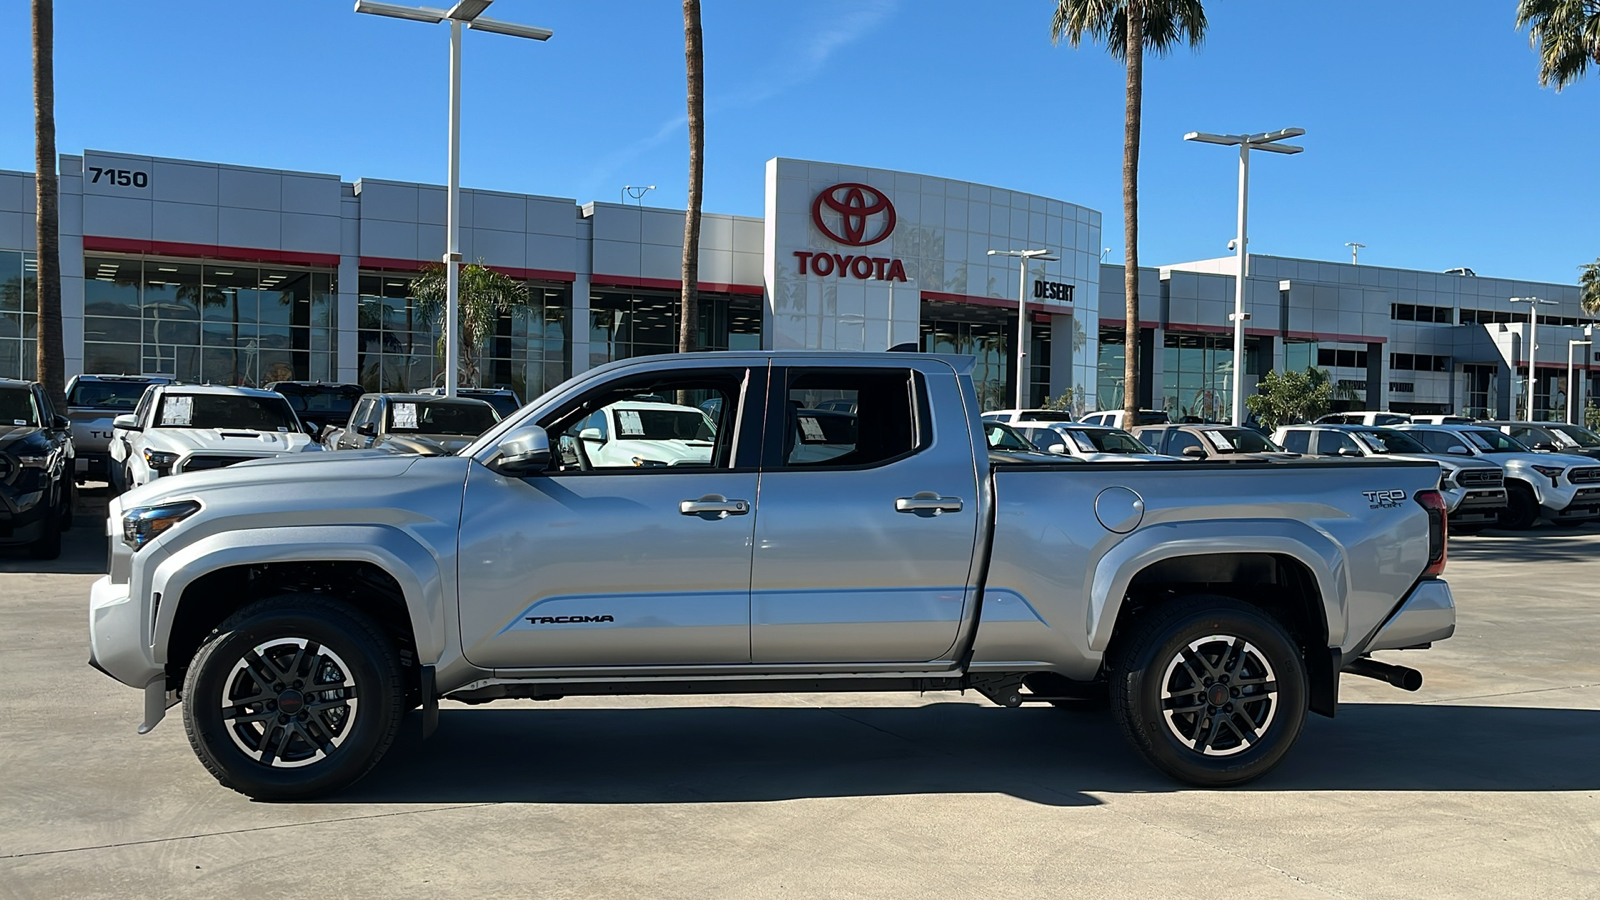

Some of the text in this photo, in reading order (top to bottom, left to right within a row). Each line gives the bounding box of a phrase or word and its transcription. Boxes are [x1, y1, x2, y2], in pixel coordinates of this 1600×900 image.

[88, 166, 148, 188] 7150
[793, 251, 908, 282] TOYOTA
[1034, 279, 1076, 302] DESERT
[90, 430, 114, 439] TU
[1361, 488, 1407, 504] TRD
[1369, 501, 1404, 510] SPORT
[525, 614, 614, 625] TACOMA
